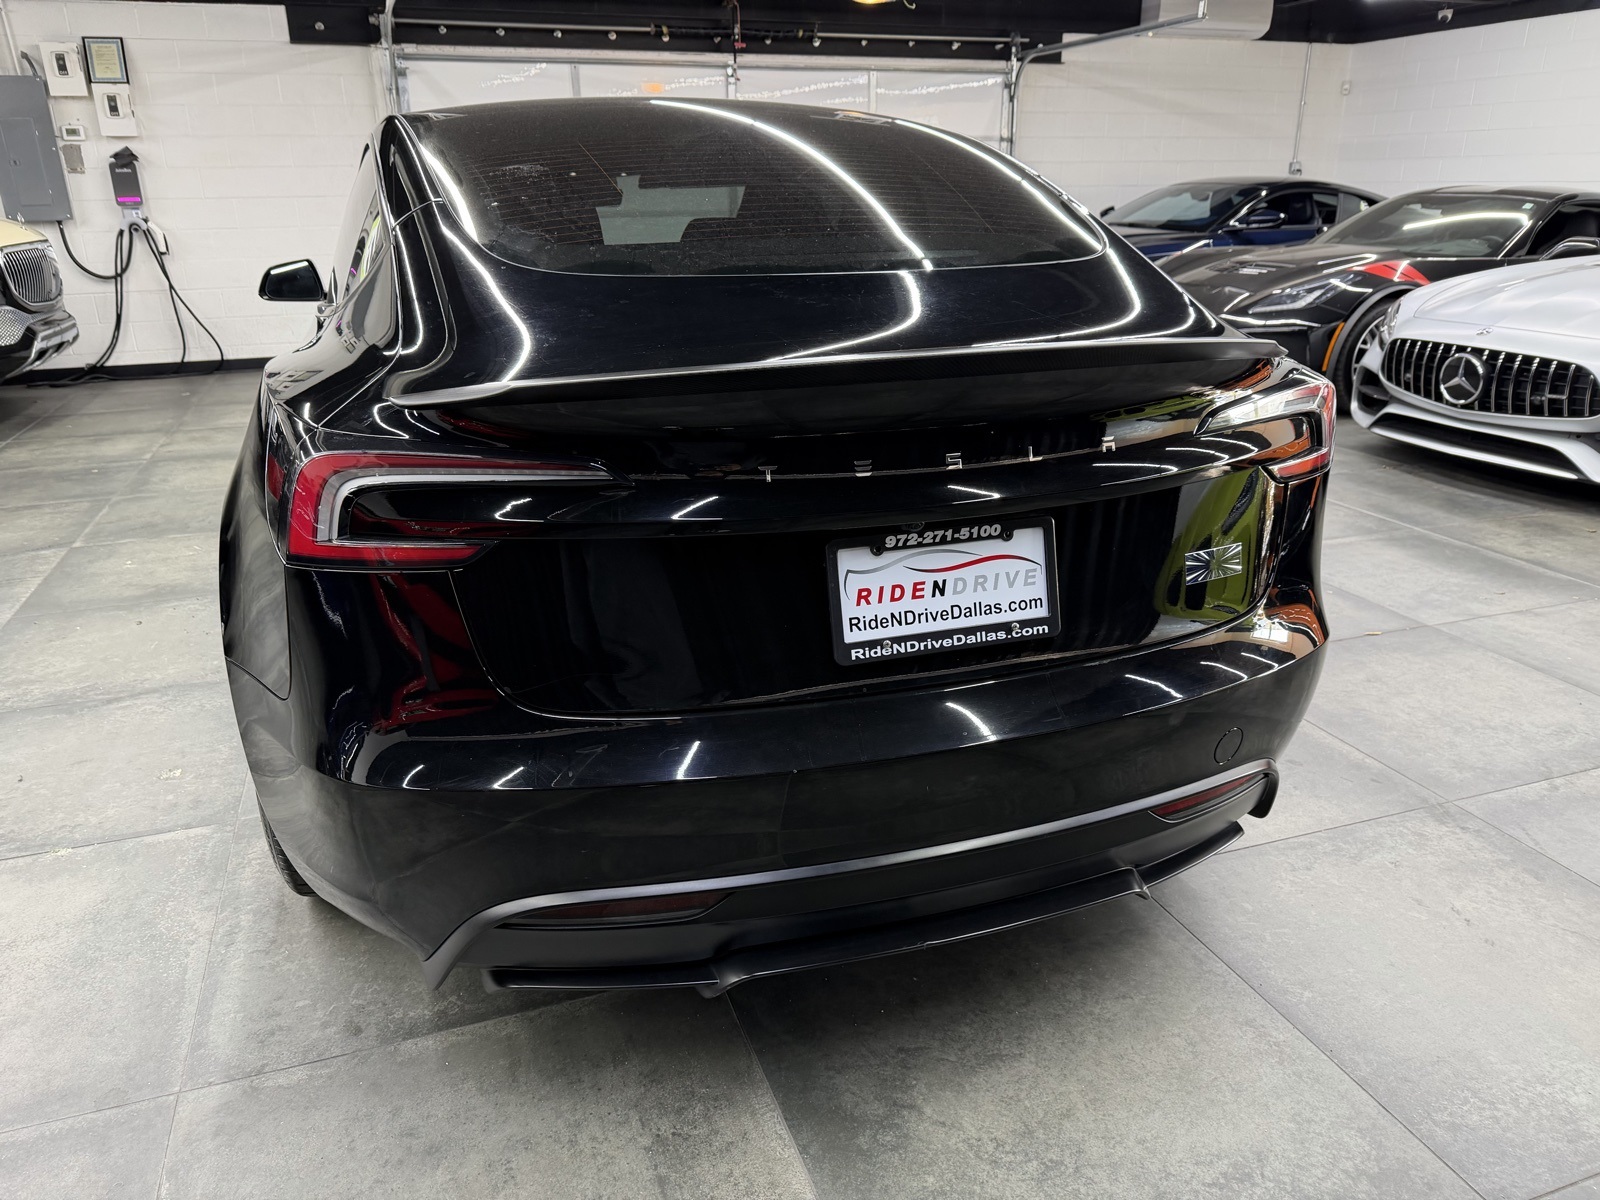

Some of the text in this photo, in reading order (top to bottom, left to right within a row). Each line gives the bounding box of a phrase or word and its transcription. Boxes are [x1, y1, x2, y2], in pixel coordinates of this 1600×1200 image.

[758, 436, 1115, 482] TESLA
[885, 524, 1002, 548] 972-271-5100
[849, 597, 1043, 632] RideNDriveDallas.com
[850, 624, 1049, 661] RideNDriveDallas.com
